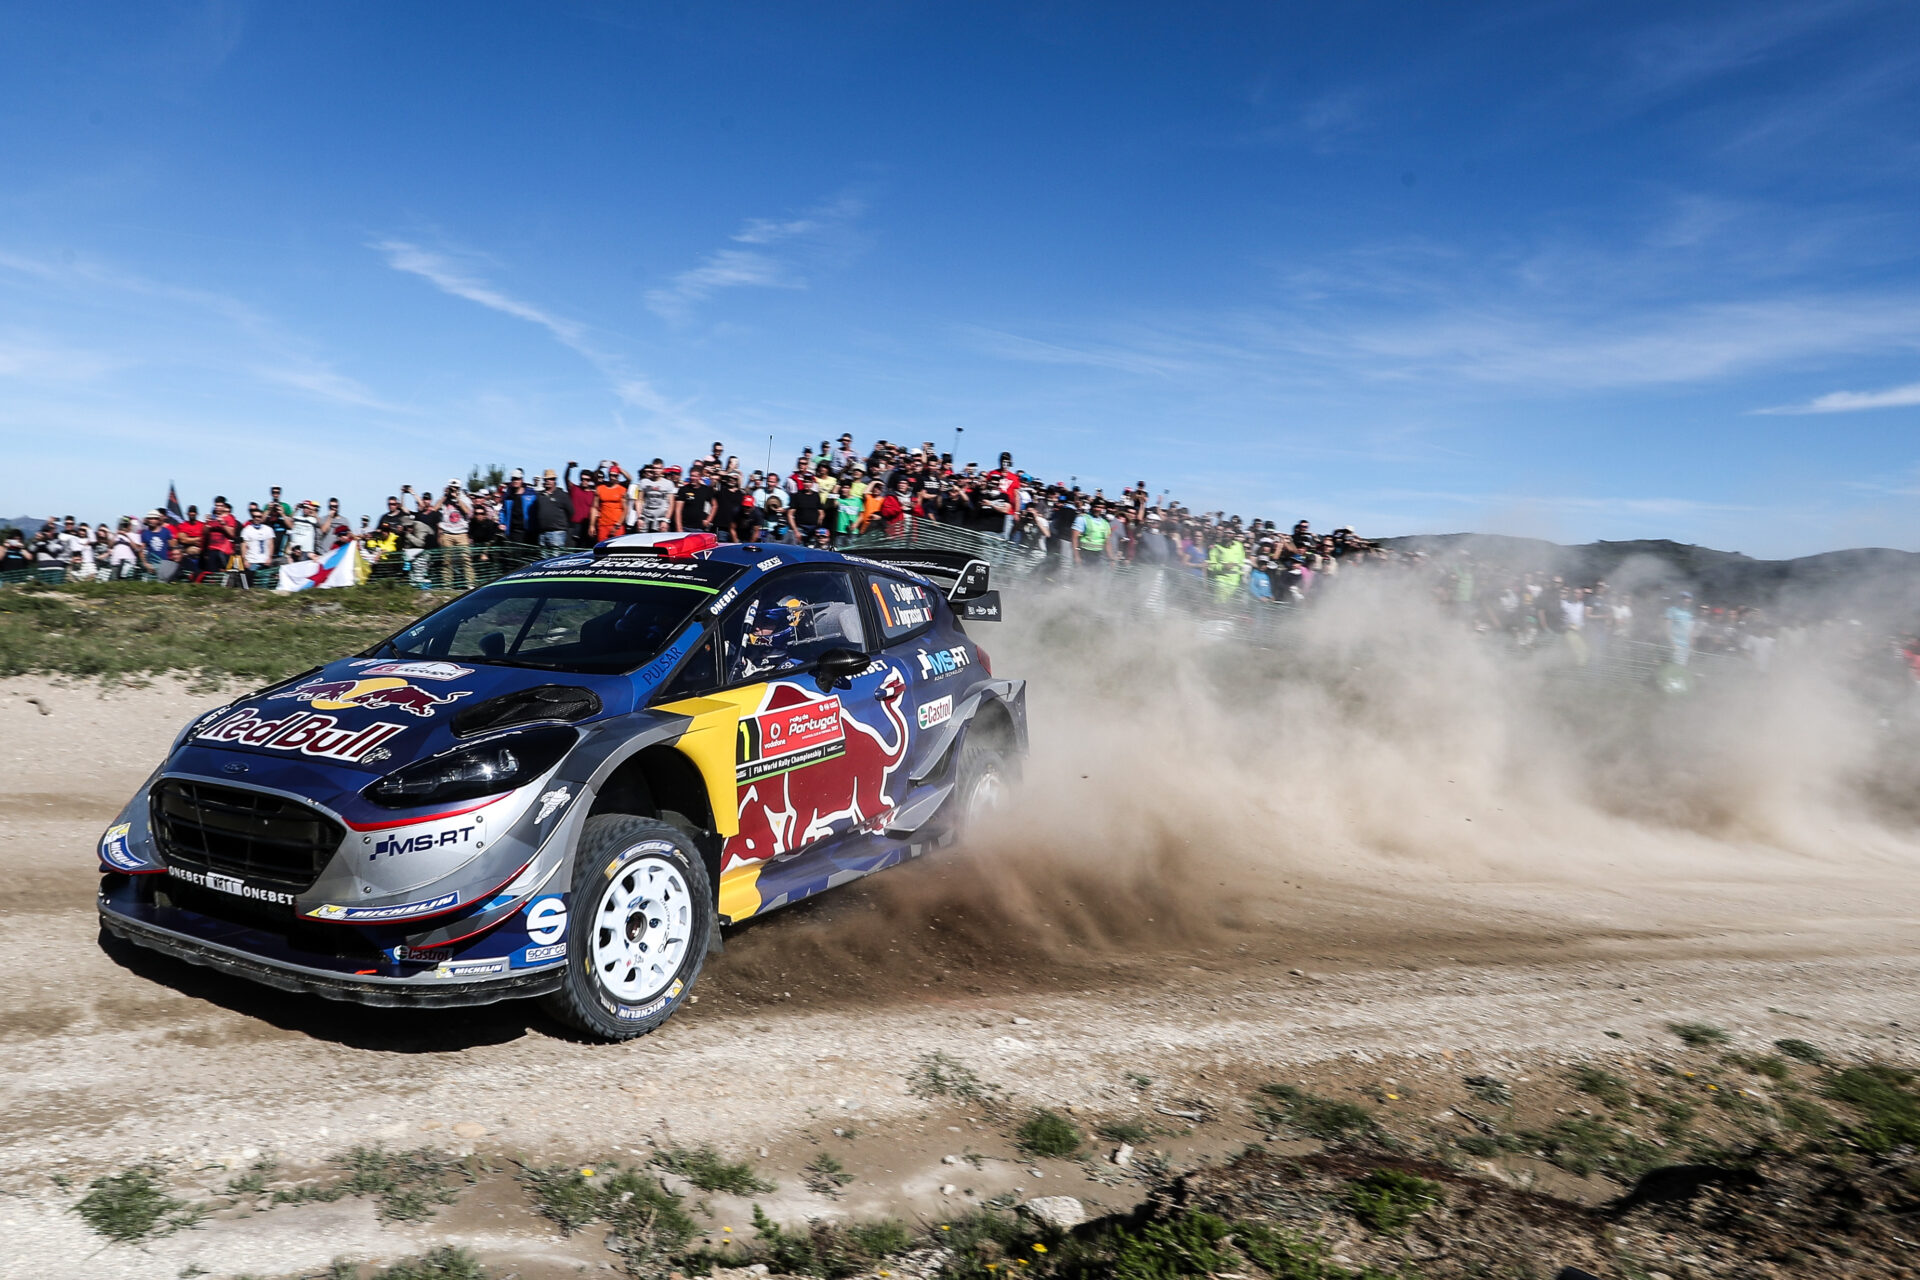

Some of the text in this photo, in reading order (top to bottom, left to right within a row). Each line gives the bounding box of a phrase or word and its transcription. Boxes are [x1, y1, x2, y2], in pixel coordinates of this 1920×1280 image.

[591, 560, 698, 571] EcoBoost
[595, 569, 661, 578] Championship
[710, 586, 739, 615] ONEBET
[871, 582, 893, 628] 1
[642, 646, 683, 685] PULSAR
[928, 699, 951, 724] Castrol
[197, 707, 311, 746] Red
[265, 714, 408, 762] Bull
[788, 712, 838, 736] Portugal
[739, 721, 750, 761] 1
[764, 739, 786, 749] vodafone
[754, 766, 763, 774] FIA
[763, 763, 778, 772] World
[778, 759, 790, 768] Rally
[791, 750, 822, 765] Championship
[389, 826, 475, 857] MS-RT
[110, 841, 142, 868] MICHELIN
[168, 865, 206, 886] ONEBET
[242, 886, 294, 905] ONEBET
[350, 894, 455, 918] MICHELIN
[408, 948, 449, 961] Castrol
[527, 945, 566, 959] sparco
[453, 964, 502, 975] MICHELIN
[619, 998, 666, 1019] MICHELIN
